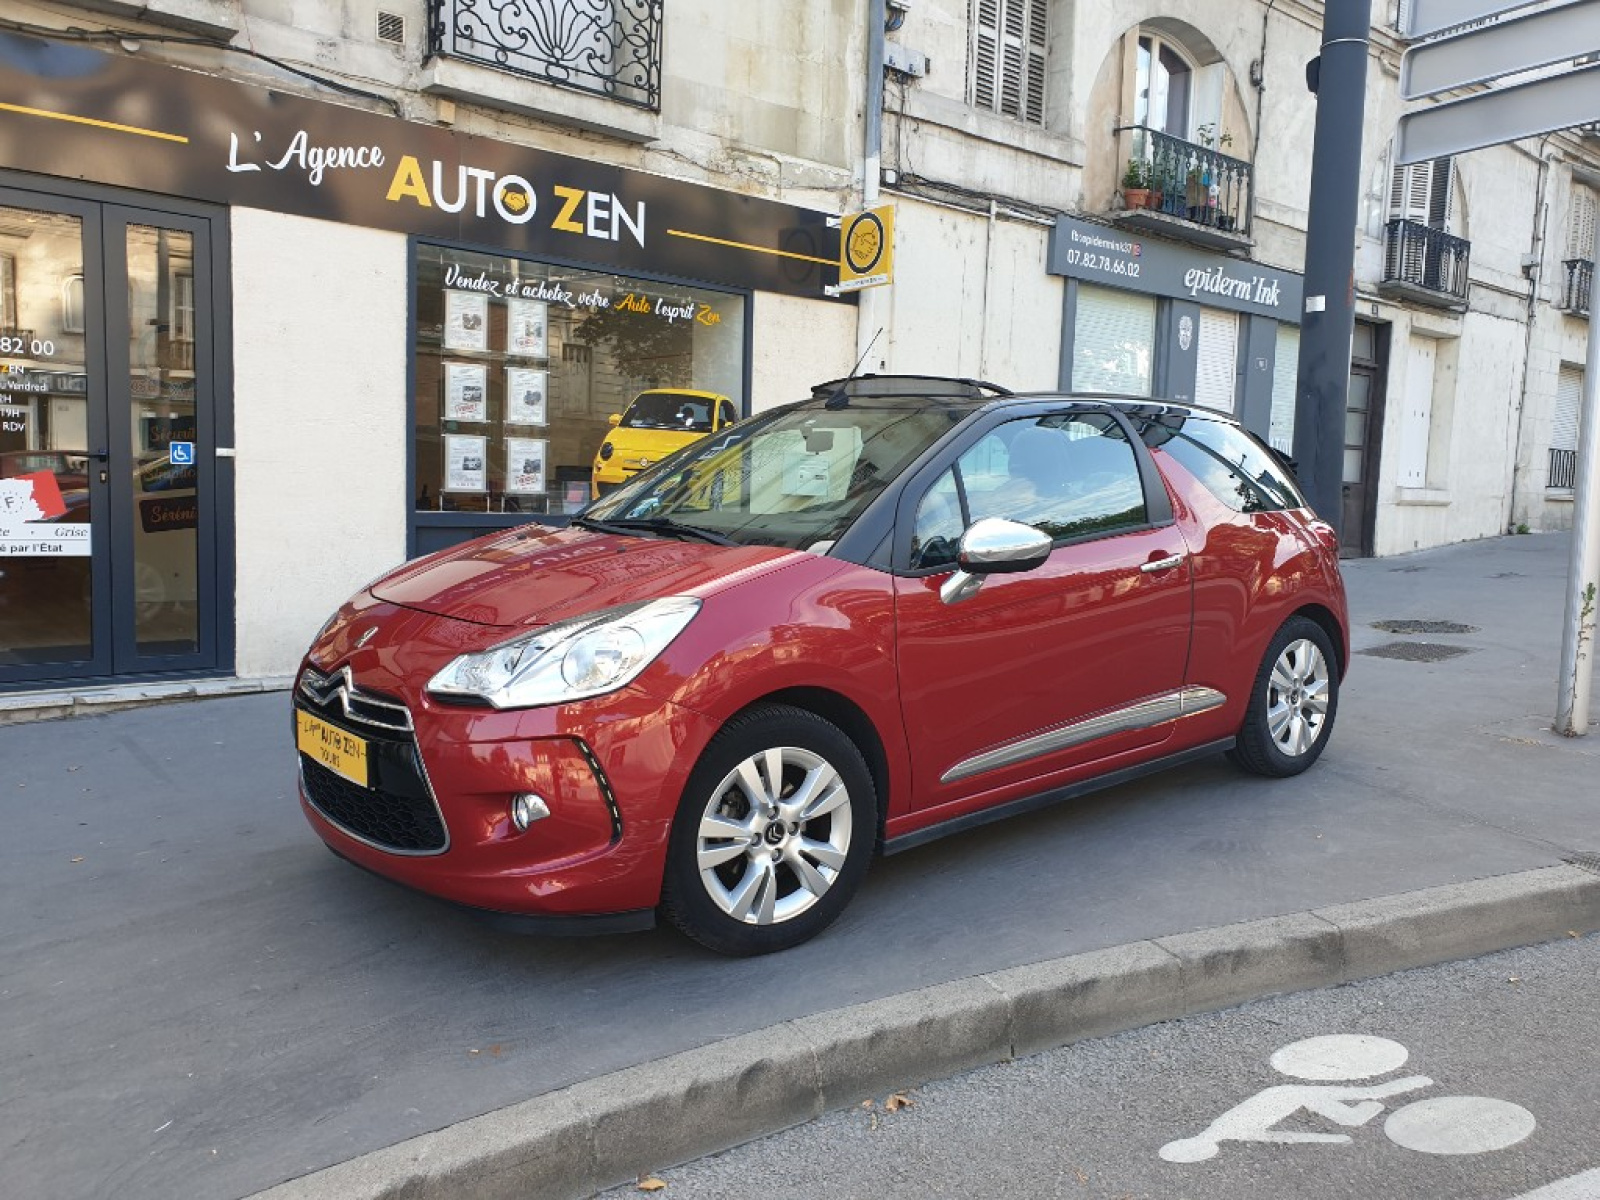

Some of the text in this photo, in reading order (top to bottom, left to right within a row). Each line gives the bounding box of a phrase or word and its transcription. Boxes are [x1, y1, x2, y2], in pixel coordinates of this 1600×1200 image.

[386, 155, 537, 224] AUTO
[551, 185, 645, 249] ZEN
[1067, 248, 1140, 277] 07.82.78.66.02
[444, 263, 502, 297] Vendez
[505, 277, 519, 295] et
[521, 280, 576, 309] achetez
[577, 289, 609, 308] votre
[613, 293, 651, 314] Auto
[696, 303, 721, 326] Zen
[0, 337, 54, 356] 82 00
[2, 421, 26, 432] RDV
[54, 526, 88, 537] Grise
[10, 544, 30, 554] par
